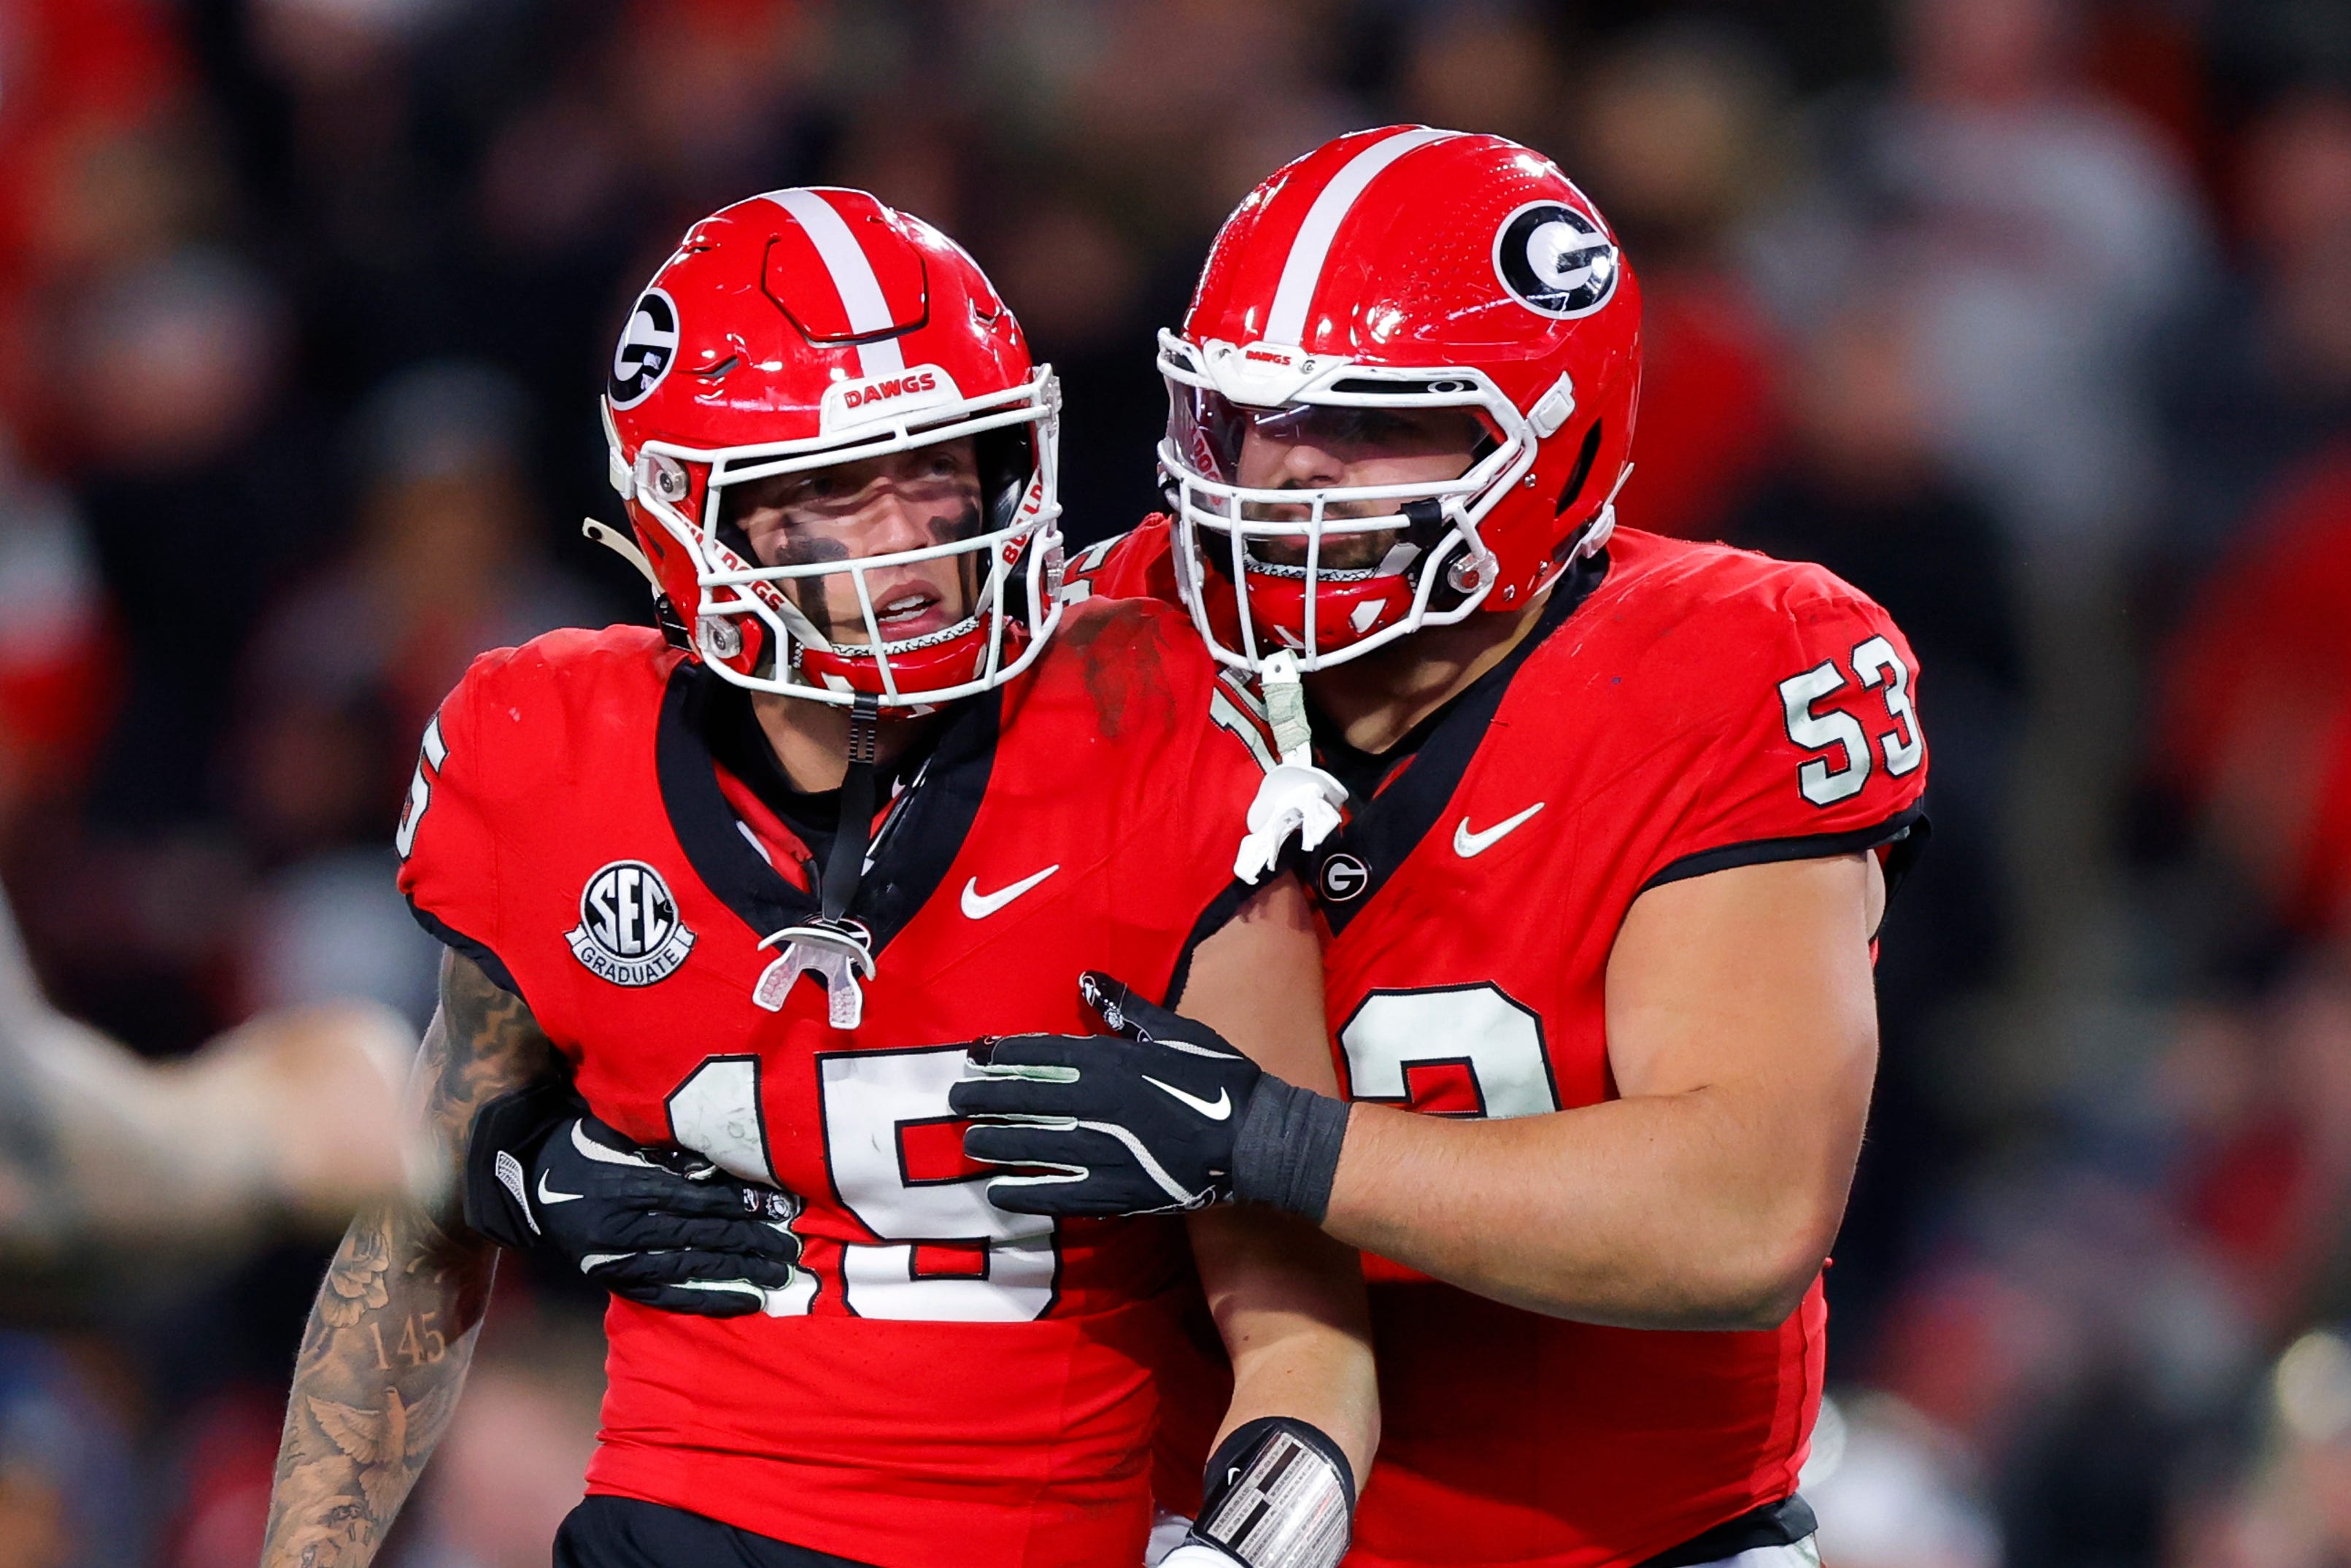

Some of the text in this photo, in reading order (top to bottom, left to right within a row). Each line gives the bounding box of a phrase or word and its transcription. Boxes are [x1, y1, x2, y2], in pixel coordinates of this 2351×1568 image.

[1494, 201, 1618, 317] G
[844, 373, 935, 409] DAWGS
[1777, 634, 1923, 808] 53
[1320, 854, 1367, 900] G
[590, 868, 669, 954] SEC
[581, 947, 680, 983] GRADUATE
